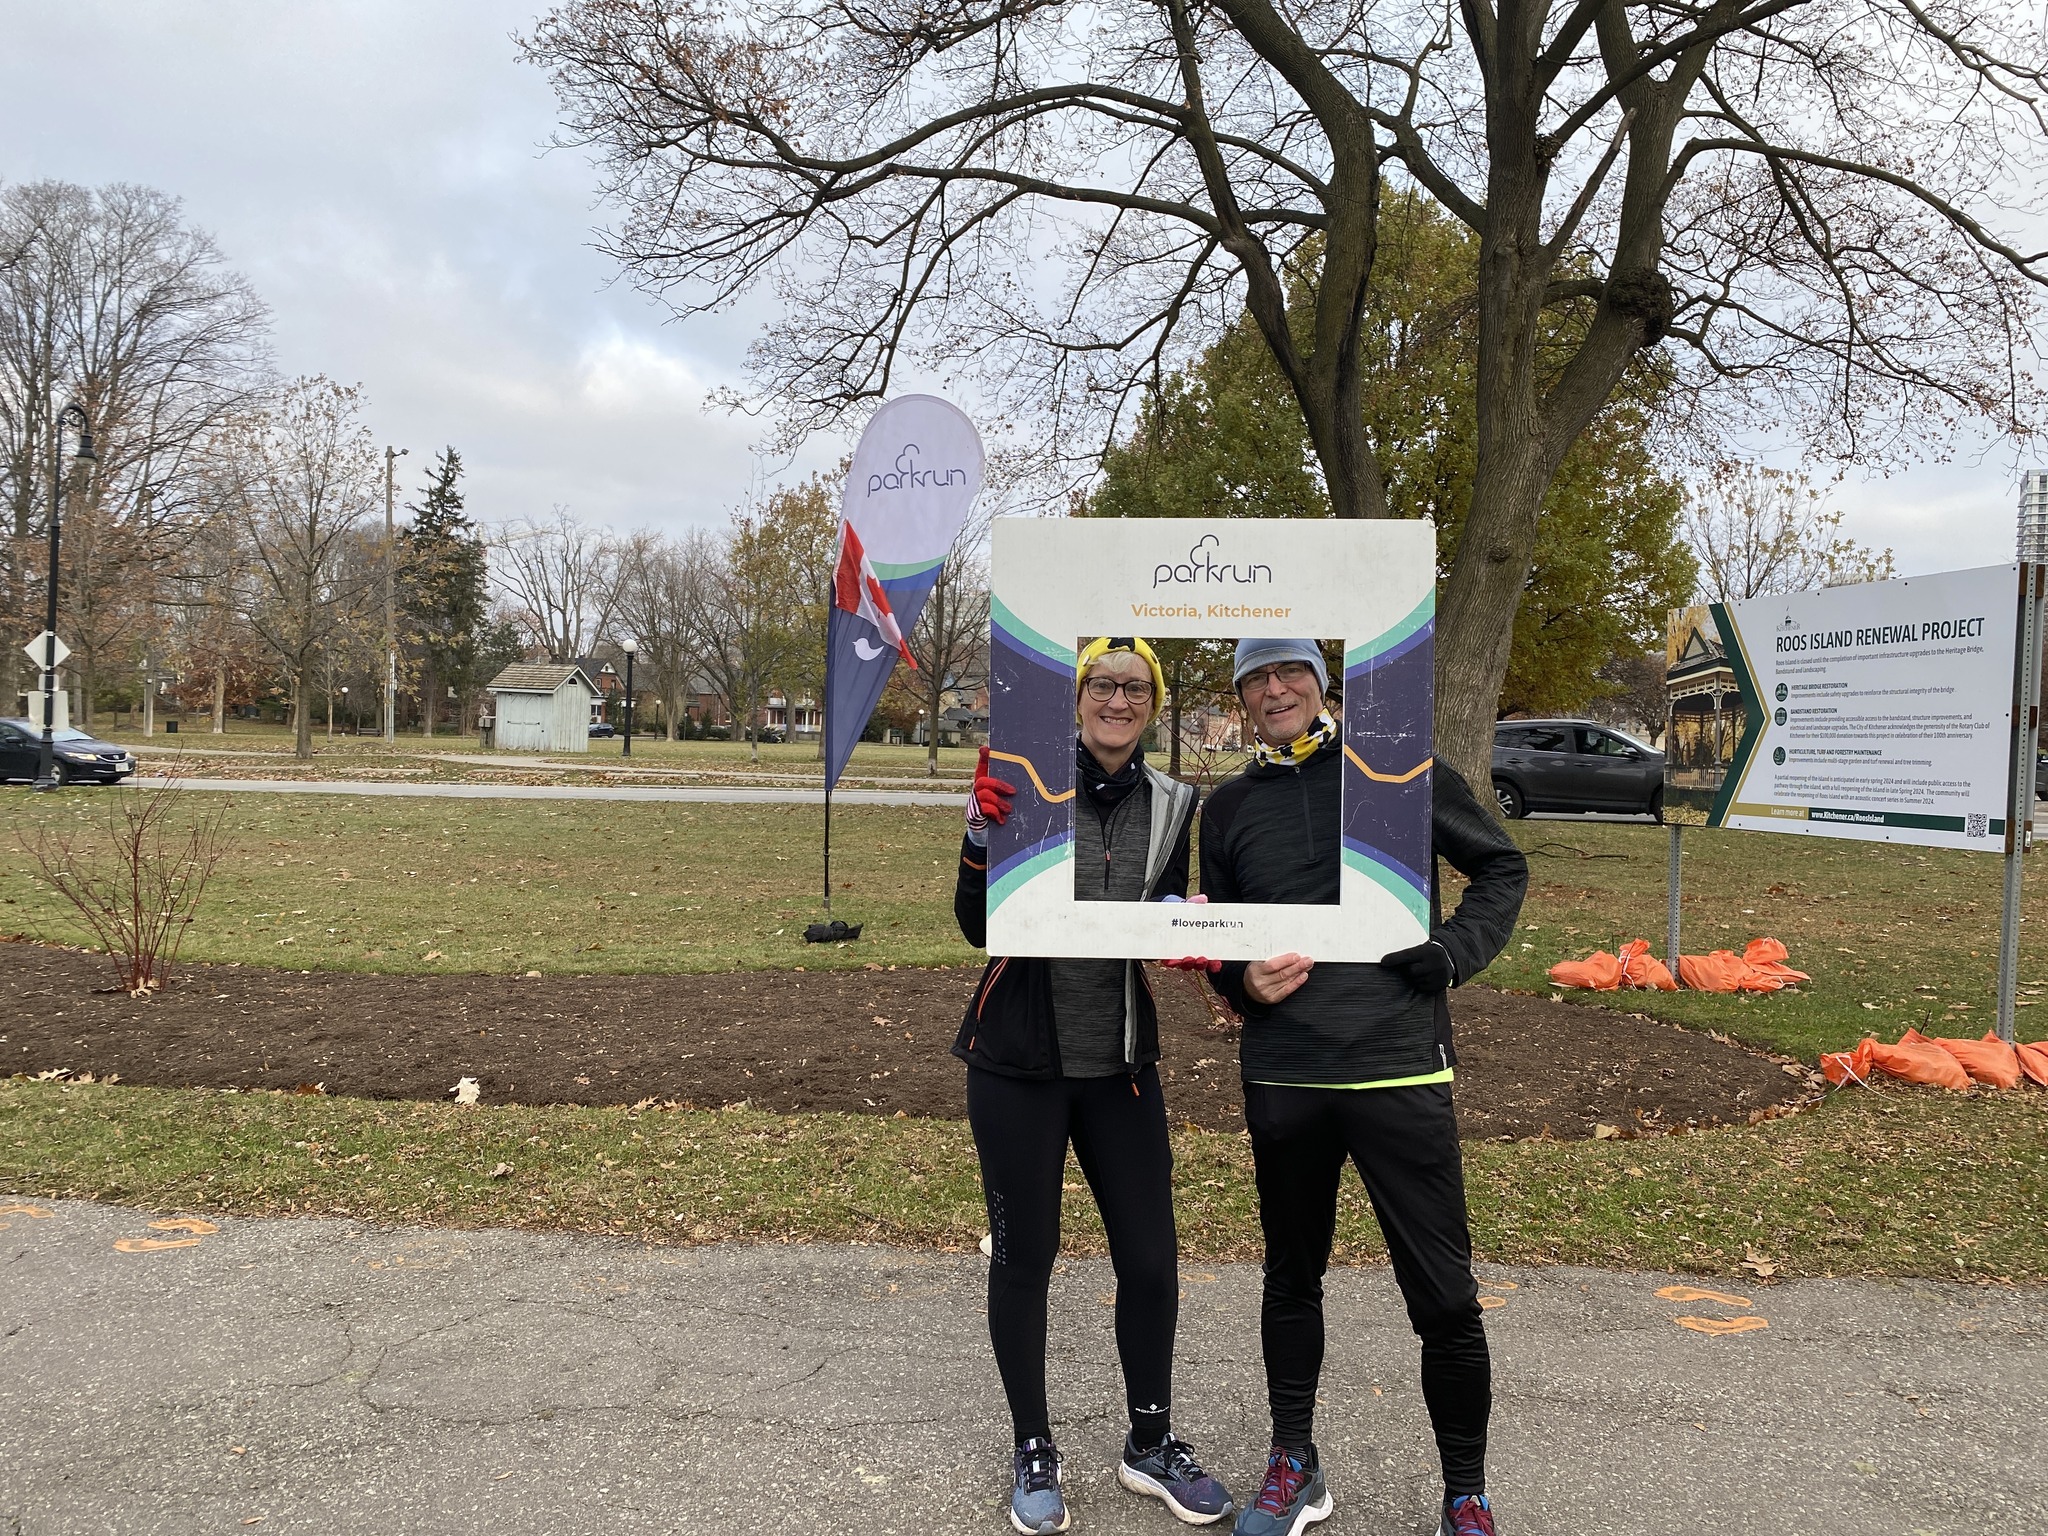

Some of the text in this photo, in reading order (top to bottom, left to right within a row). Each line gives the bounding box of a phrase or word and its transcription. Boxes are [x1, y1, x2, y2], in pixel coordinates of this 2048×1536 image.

[867, 453, 966, 497] parkrun
[1153, 548, 1271, 588] parkrun
[1132, 604, 1292, 620] Victoria, Kitchener
[1776, 617, 1985, 653] ROOS ISLAND RENEWAL PROJECT
[1842, 690, 1859, 698] upgrades
[1771, 808, 1786, 816] Learn
